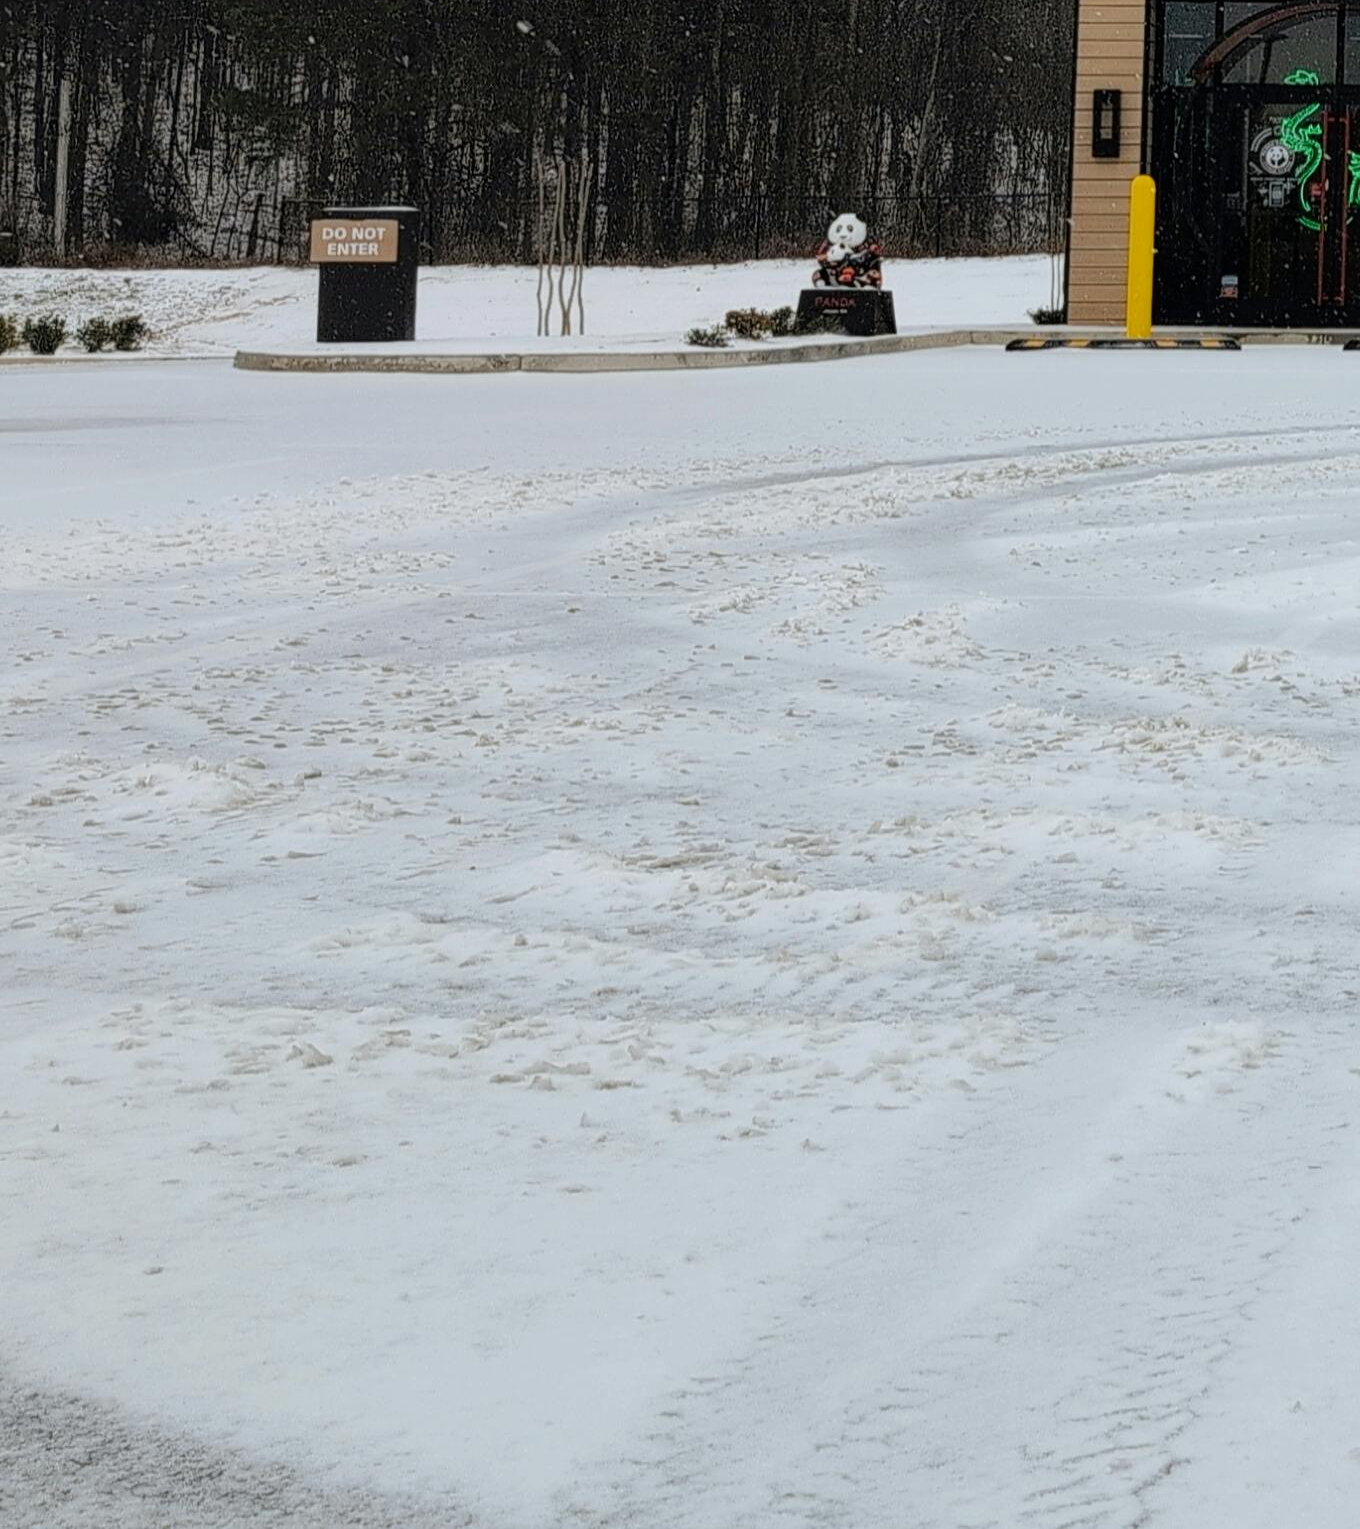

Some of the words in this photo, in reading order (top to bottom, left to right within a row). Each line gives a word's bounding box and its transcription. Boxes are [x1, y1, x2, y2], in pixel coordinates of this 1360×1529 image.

[322, 227, 347, 241] DO
[351, 227, 386, 241] NOT
[327, 242, 379, 256] ENTER
